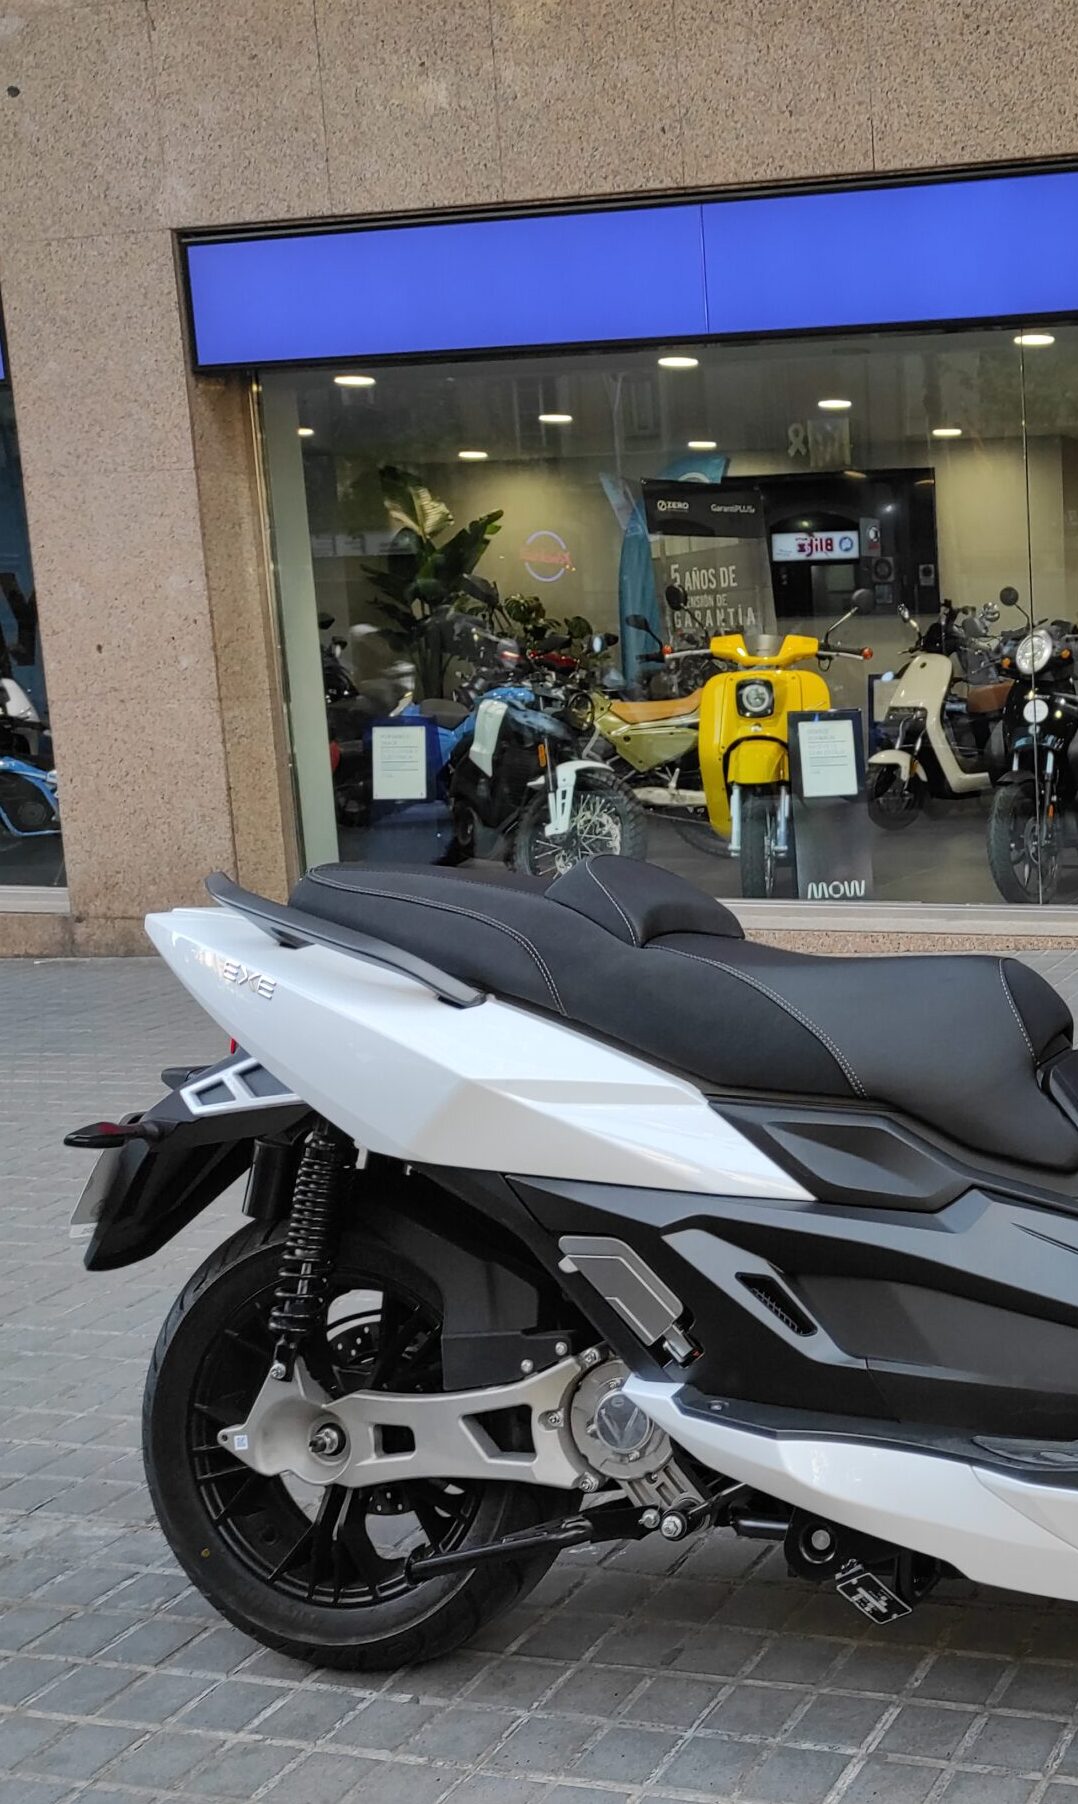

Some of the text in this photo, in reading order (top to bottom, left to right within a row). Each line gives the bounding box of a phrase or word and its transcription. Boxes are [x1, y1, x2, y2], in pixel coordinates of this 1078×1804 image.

[667, 501, 689, 510] ZERO
[670, 564, 738, 591] 5 AÑOS DE
[716, 594, 728, 607] DE
[673, 604, 757, 628] GARANTÍA
[807, 879, 866, 900] MOW
[222, 960, 278, 1000] EXE
